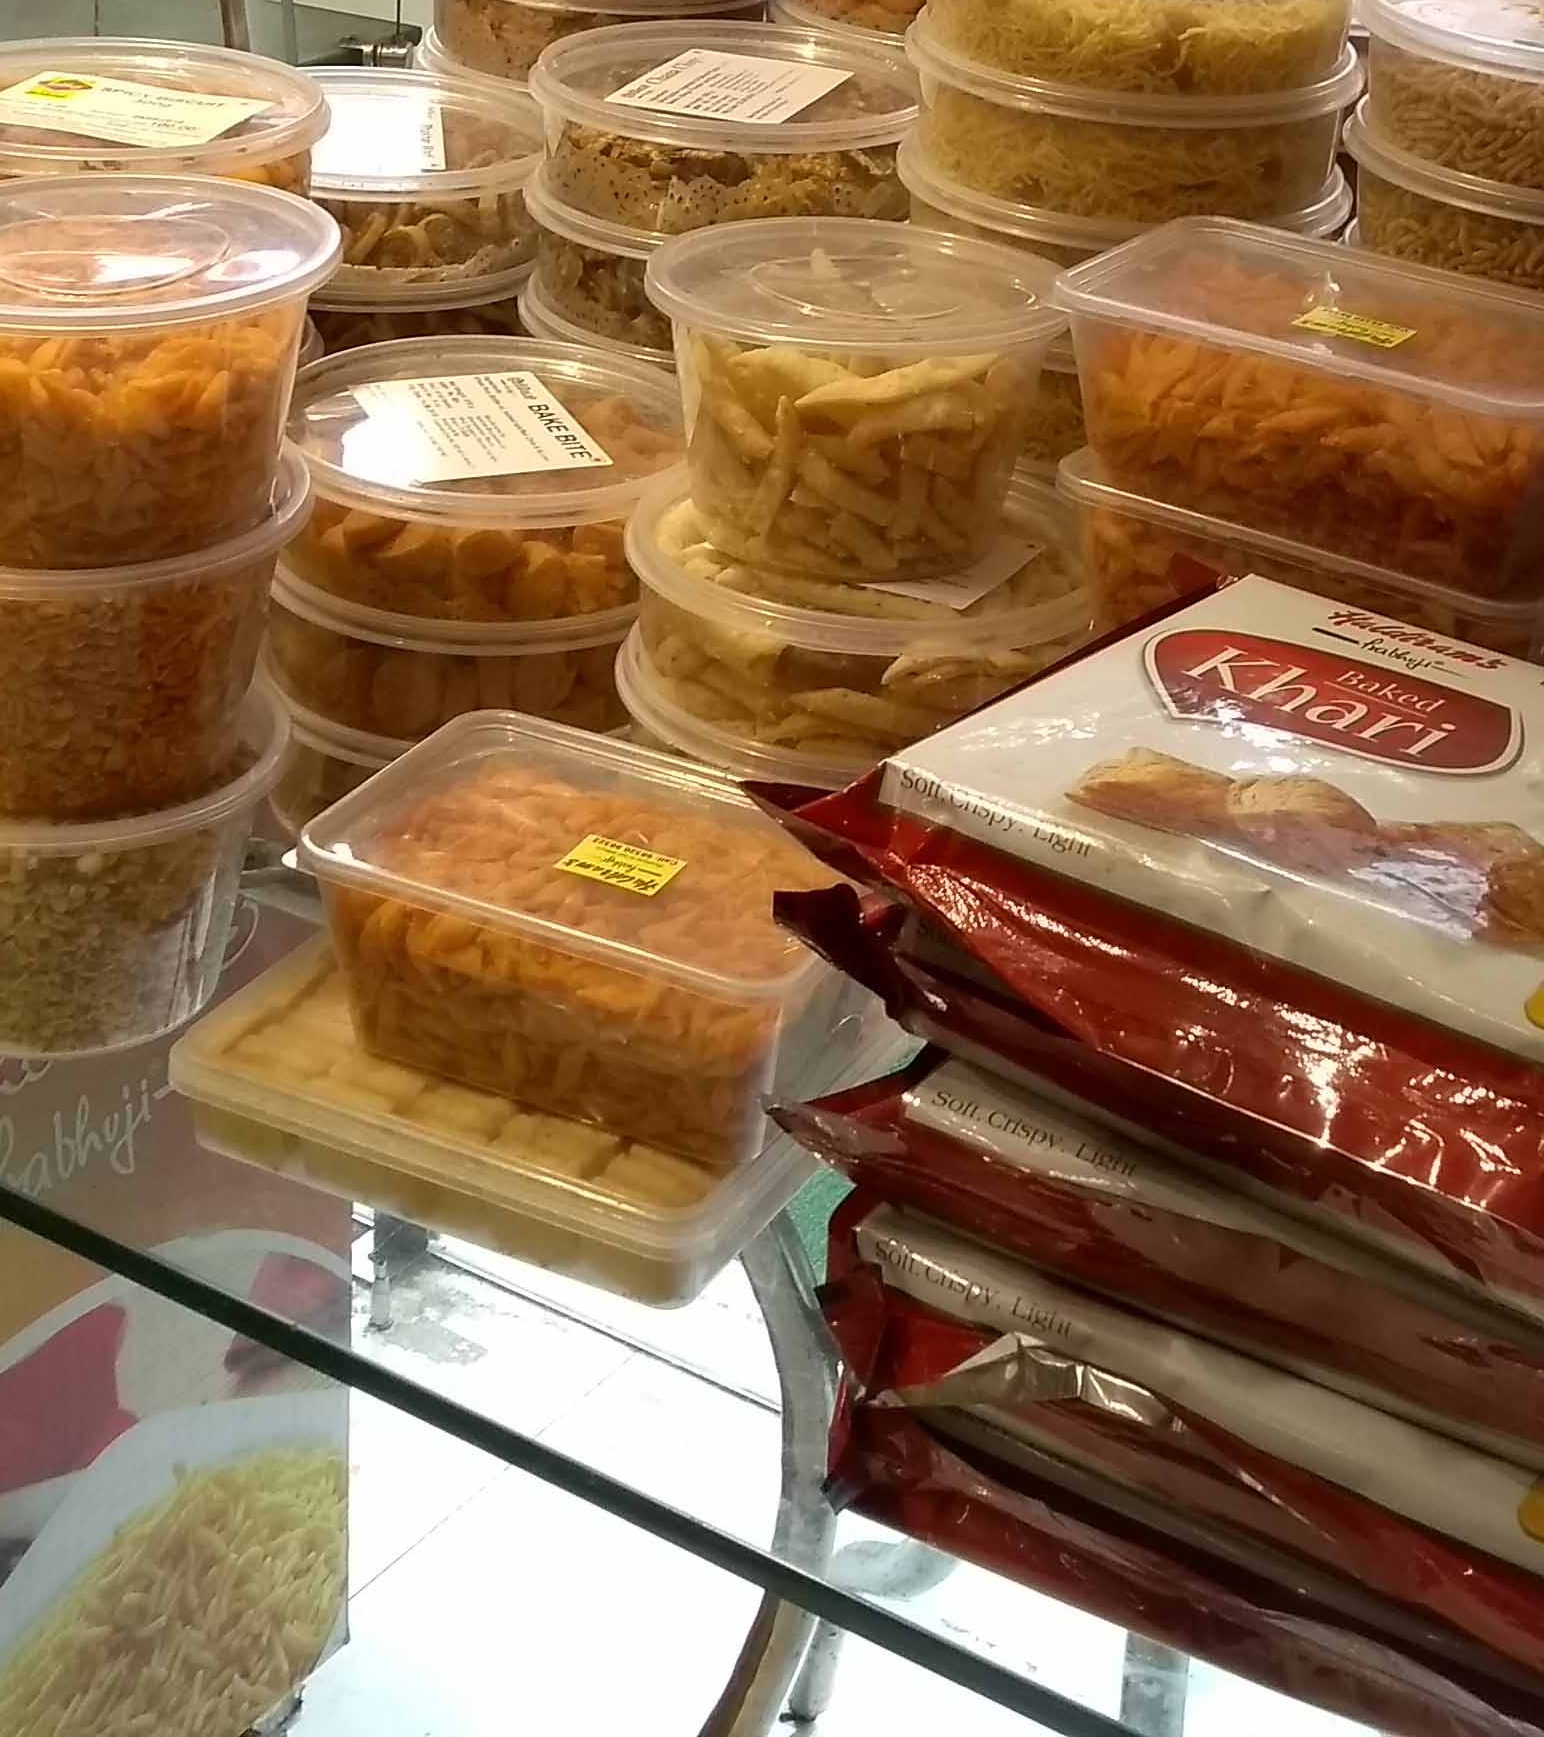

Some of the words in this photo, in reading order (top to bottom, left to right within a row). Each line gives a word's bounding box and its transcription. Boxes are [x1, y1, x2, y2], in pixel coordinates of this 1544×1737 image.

[528, 404, 570, 434] BAKE
[554, 431, 593, 461] BITE
[1180, 644, 1457, 758] Khari
[1335, 669, 1447, 713] Baked
[1074, 1141, 1137, 1178] Light
[1011, 1294, 1073, 1340] Light
